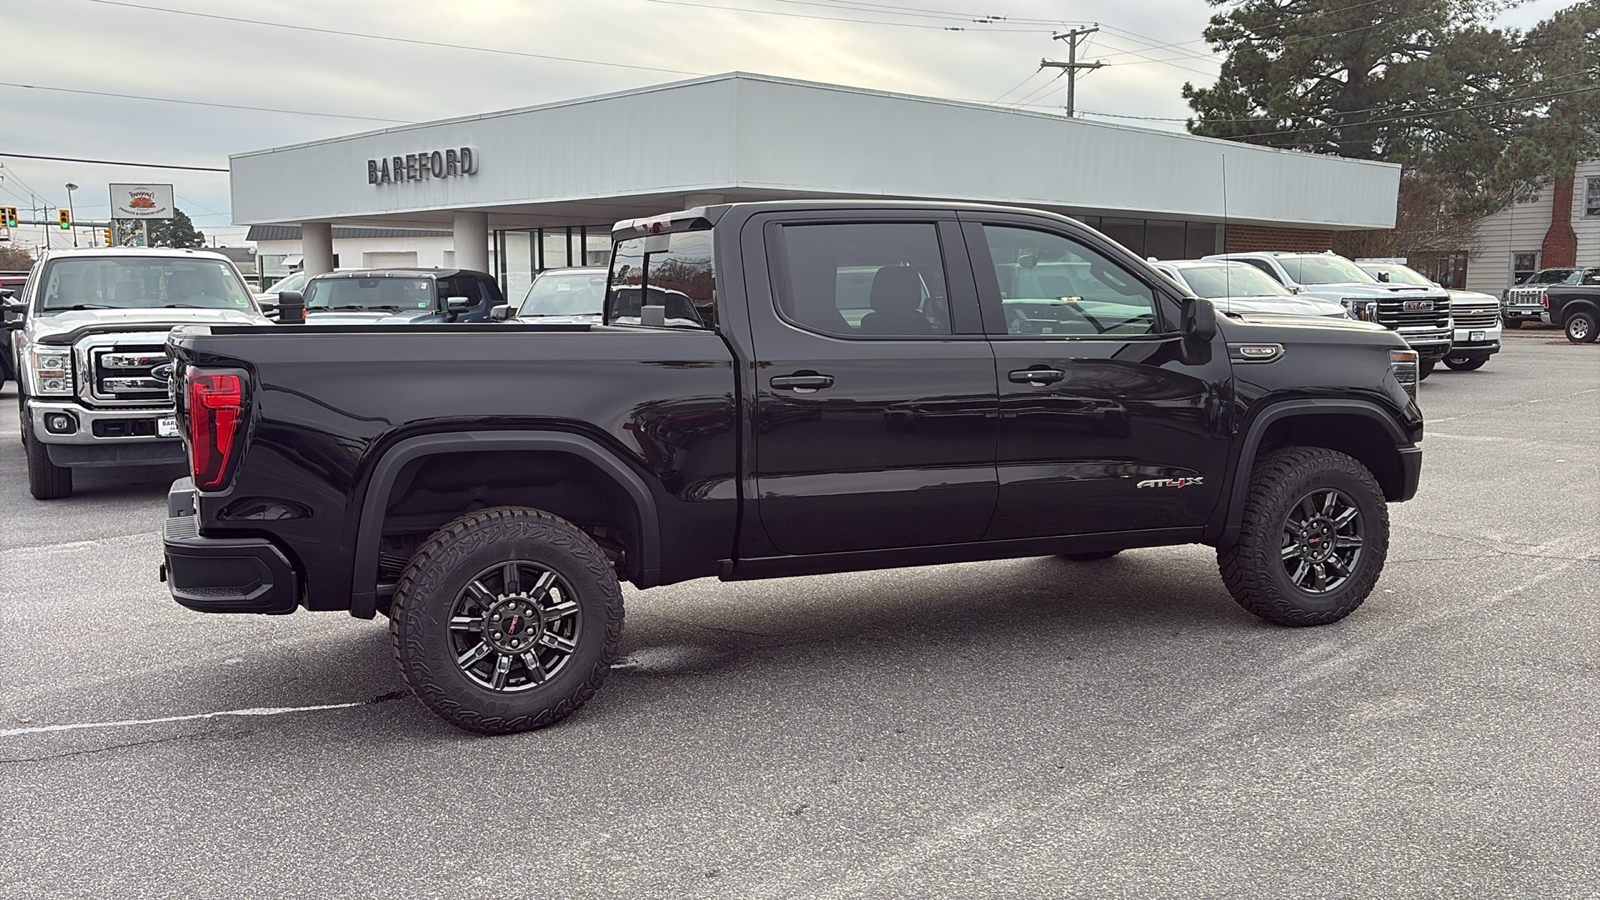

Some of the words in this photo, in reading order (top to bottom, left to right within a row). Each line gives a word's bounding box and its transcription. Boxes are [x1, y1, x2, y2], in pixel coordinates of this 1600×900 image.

[366, 147, 478, 185] BAREFORD
[155, 206, 167, 214] STORE
[1136, 477, 1204, 489] AT4X
[508, 614, 519, 635] GMC
